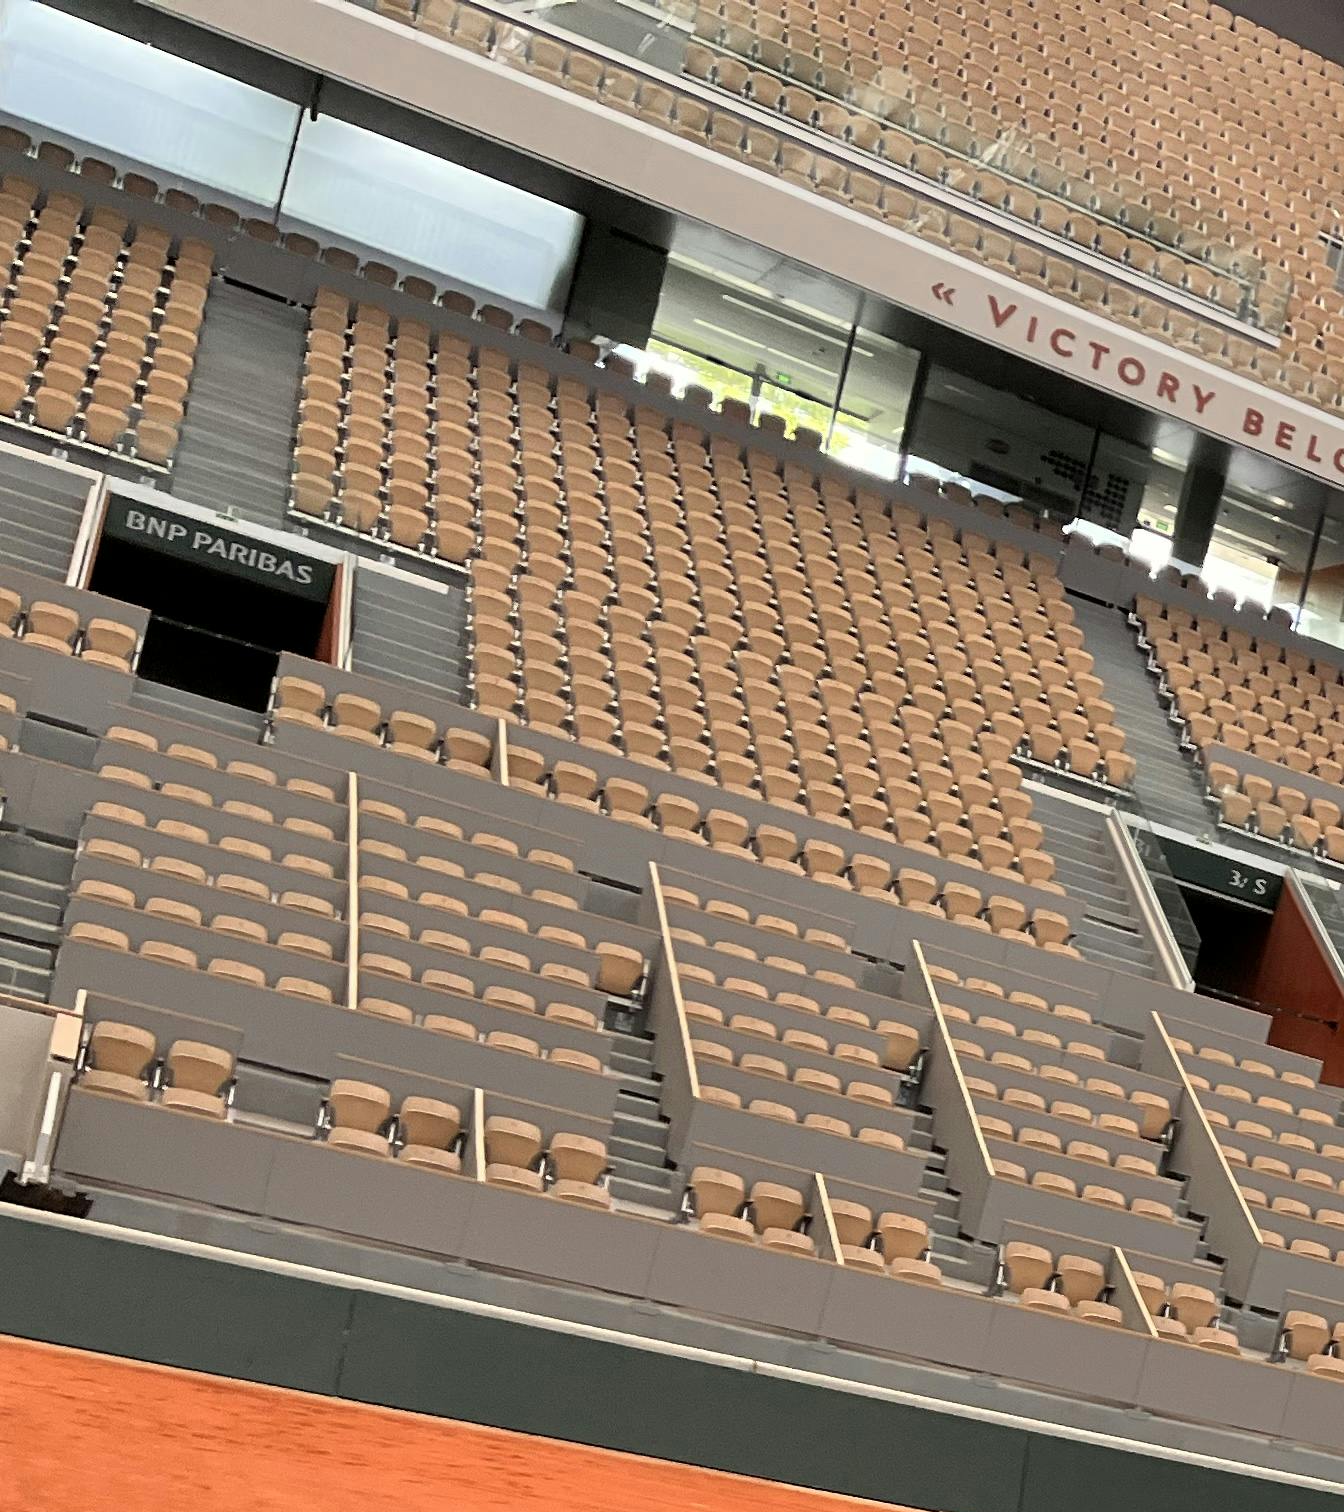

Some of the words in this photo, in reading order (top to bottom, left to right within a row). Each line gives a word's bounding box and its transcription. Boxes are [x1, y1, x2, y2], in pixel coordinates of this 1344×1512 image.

[987, 293, 1217, 414] VICTORY
[125, 509, 188, 542] BNP
[192, 531, 313, 586] PARIBAS
